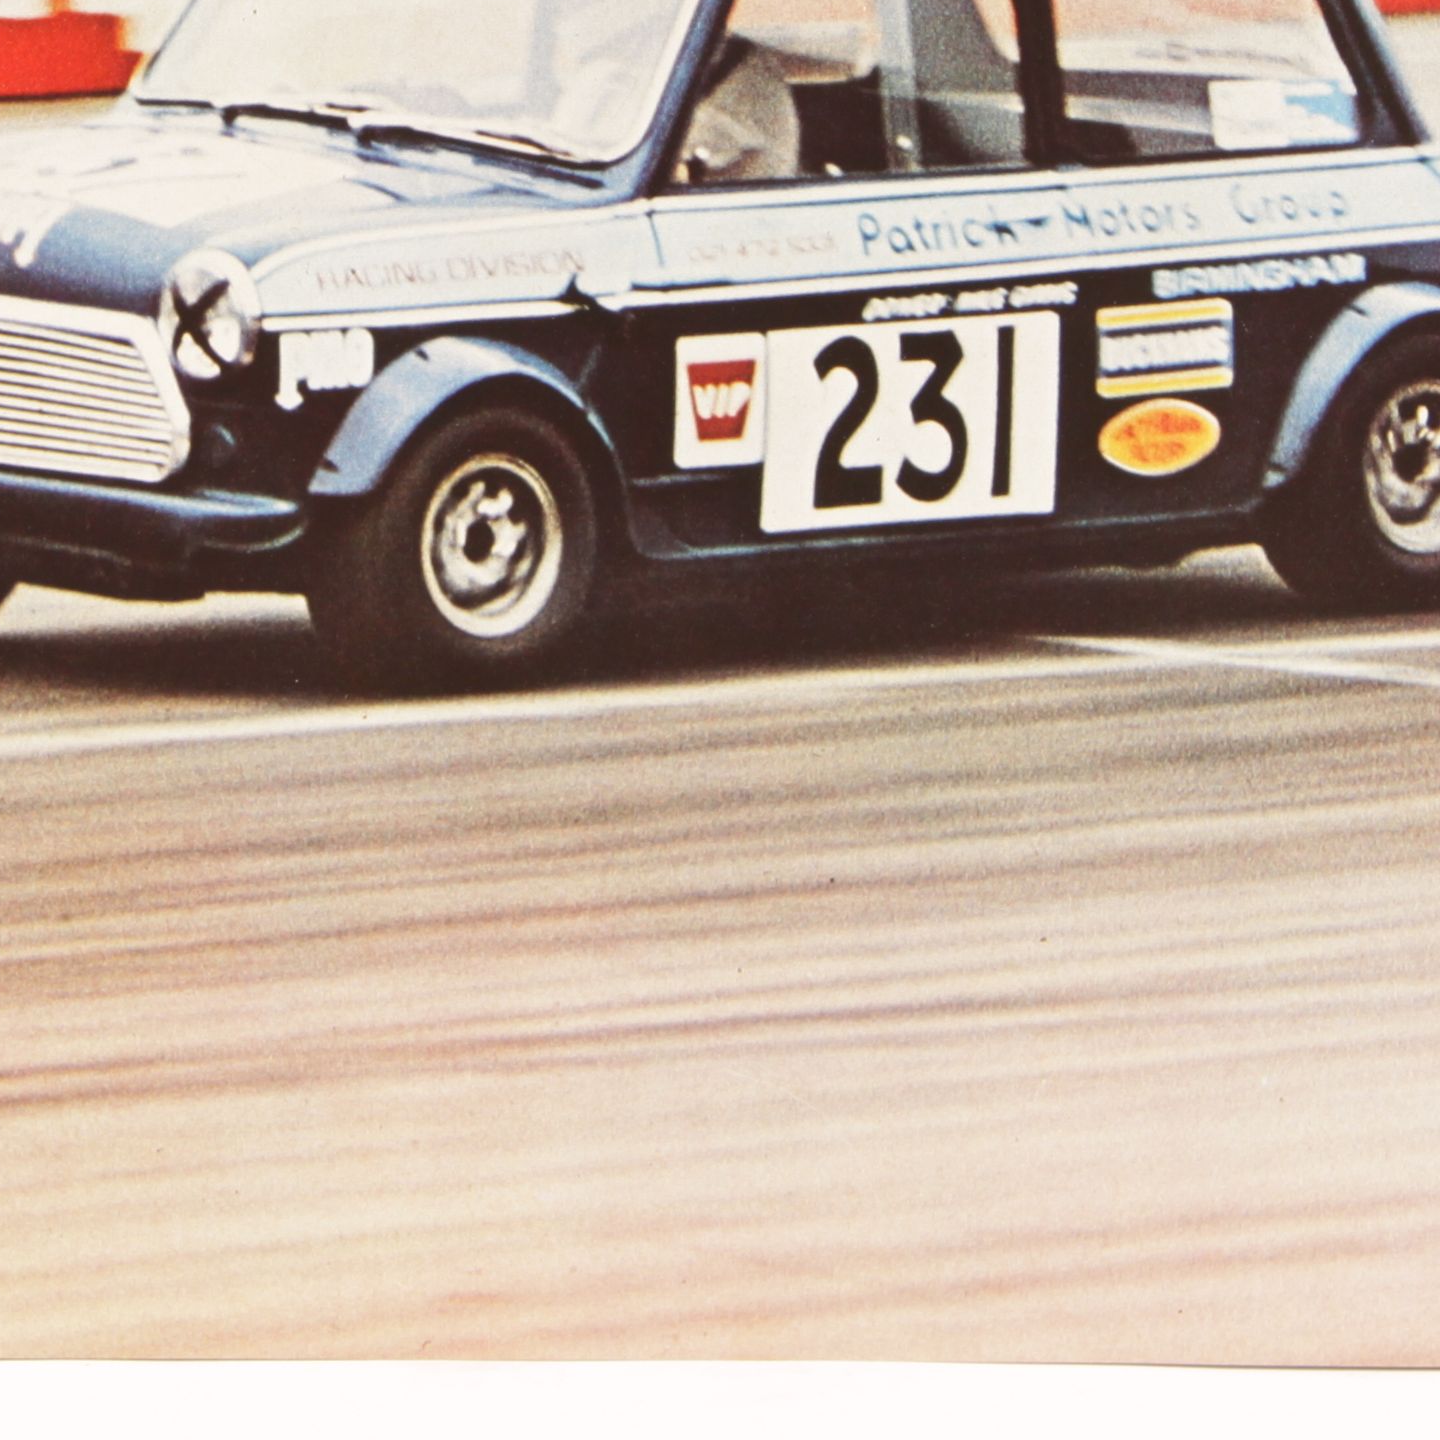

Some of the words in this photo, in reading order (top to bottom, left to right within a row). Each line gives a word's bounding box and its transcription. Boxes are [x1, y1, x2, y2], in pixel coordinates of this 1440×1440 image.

[857, 205, 1019, 256] Patrick
[1061, 201, 1201, 238] Motors
[1229, 184, 1349, 224] Group
[316, 262, 437, 291] RACING
[446, 251, 585, 279] DIVISION
[692, 380, 752, 420] VIP
[813, 325, 1016, 509] 231
